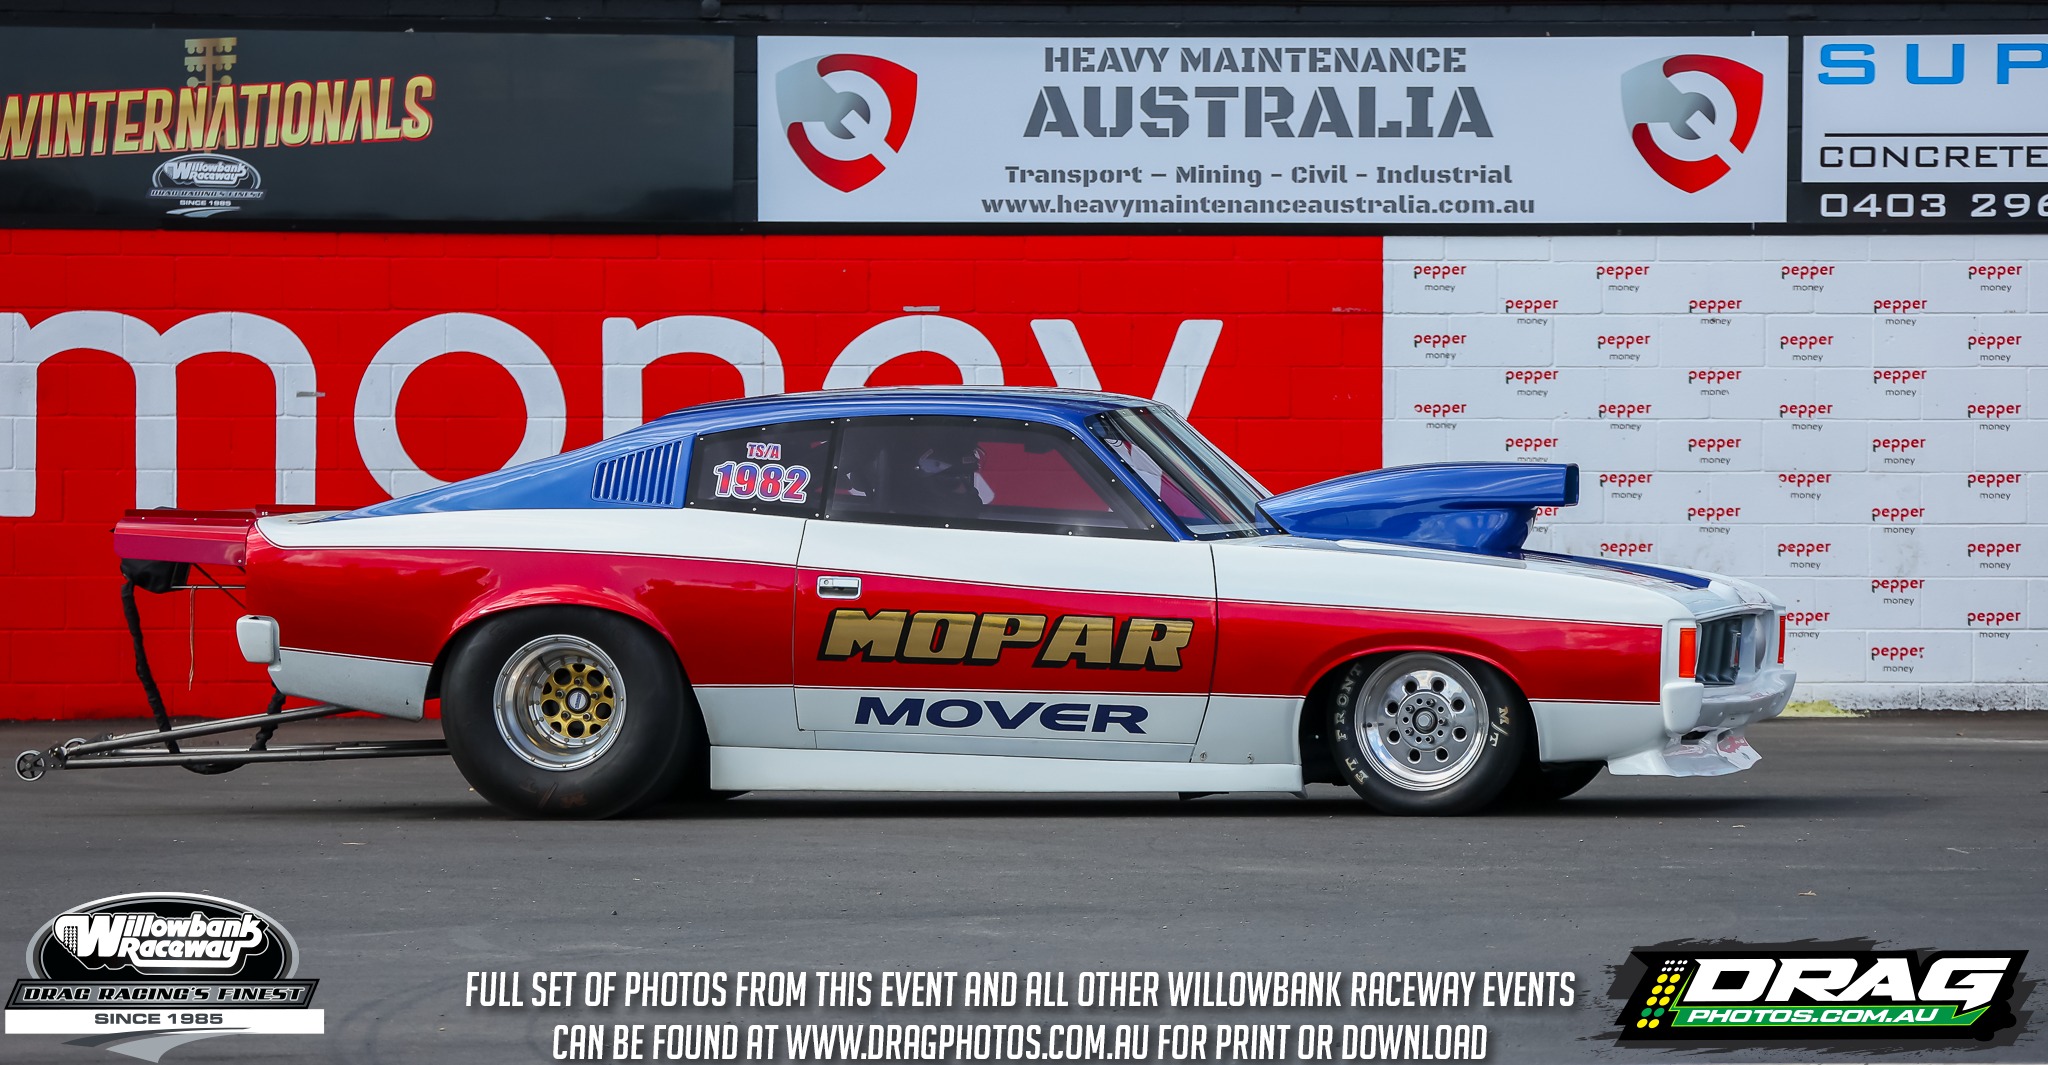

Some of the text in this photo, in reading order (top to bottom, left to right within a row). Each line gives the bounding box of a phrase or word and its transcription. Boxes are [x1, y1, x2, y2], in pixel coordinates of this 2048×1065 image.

[1044, 47, 1467, 73] HEAVY MAINTENANCE
[0, 75, 435, 160] WINTERNATIONALS
[1022, 86, 1494, 138] AUSTRALIA
[1820, 146, 2048, 168] CONCRETE
[164, 161, 248, 180] Willowbank
[1005, 166, 1142, 187] Transport
[1176, 165, 1262, 187] Mining
[1291, 165, 1348, 183] Civil
[1376, 165, 1513, 183] Industrial
[981, 195, 1535, 217] www.heavymaintenanceaustralia.com.au
[1820, 193, 1946, 218] 0403
[1414, 266, 1467, 280] pepper
[1597, 266, 1650, 280] pepper
[1782, 266, 1835, 280] pepper
[1969, 266, 2022, 280] pepper
[1425, 284, 1455, 293] money
[1609, 284, 1639, 293] money
[1793, 284, 1824, 293] money
[1981, 284, 2011, 293] money
[1506, 299, 1559, 313] pepper
[1689, 300, 1742, 314] pepper
[1874, 300, 1927, 314] pepper
[1517, 317, 1547, 326] money
[1886, 317, 1916, 327] money
[1414, 335, 1467, 349] pepper
[1598, 335, 1651, 349] pepper
[1780, 336, 1833, 350] pepper
[1968, 336, 2021, 350] pepper
[1426, 352, 1456, 361] money
[1610, 353, 1640, 362] money
[1793, 354, 1823, 363] money
[1980, 354, 2011, 363] money
[1506, 370, 1559, 384] pepper
[1689, 370, 1742, 384] pepper
[1874, 370, 1927, 384] pepper
[1517, 389, 1548, 398] money
[1886, 389, 1916, 398] money
[1599, 404, 1652, 418] pepper
[1780, 404, 1833, 418] pepper
[1968, 405, 2021, 419] pepper
[1427, 422, 1456, 431] money
[1611, 423, 1641, 432] money
[1792, 423, 1823, 432] money
[1980, 423, 2010, 432] money
[747, 442, 782, 461] TS/A
[1506, 438, 1559, 452] pepper
[1688, 438, 1741, 452] pepper
[1873, 439, 1926, 453] pepper
[1700, 457, 1730, 466] money
[1885, 457, 1915, 466] money
[713, 461, 811, 503] 1982
[1600, 474, 1653, 488] pepper
[1968, 474, 2021, 488] pepper
[1612, 492, 1642, 501] money
[1791, 492, 1821, 501] money
[1980, 492, 2011, 501] money
[1688, 508, 1741, 522] pepper
[1872, 508, 1925, 522] pepper
[1700, 526, 1730, 535] money
[1884, 527, 1915, 536] money
[1600, 542, 1653, 556] pepper
[1778, 543, 1831, 557] pepper
[1968, 543, 2021, 557] pepper
[1791, 561, 1820, 570] money
[1980, 562, 2010, 571] money
[1872, 579, 1925, 593] pepper
[1884, 597, 1914, 606] money
[1786, 612, 1830, 626] epper
[1968, 612, 2021, 626] pepper
[817, 607, 1195, 672] MOPAR
[1789, 631, 1820, 640] money
[1980, 631, 2010, 640] money
[1884, 665, 1914, 674] money
[1333, 663, 1362, 743] FRONT
[854, 696, 1149, 735] MOVER
